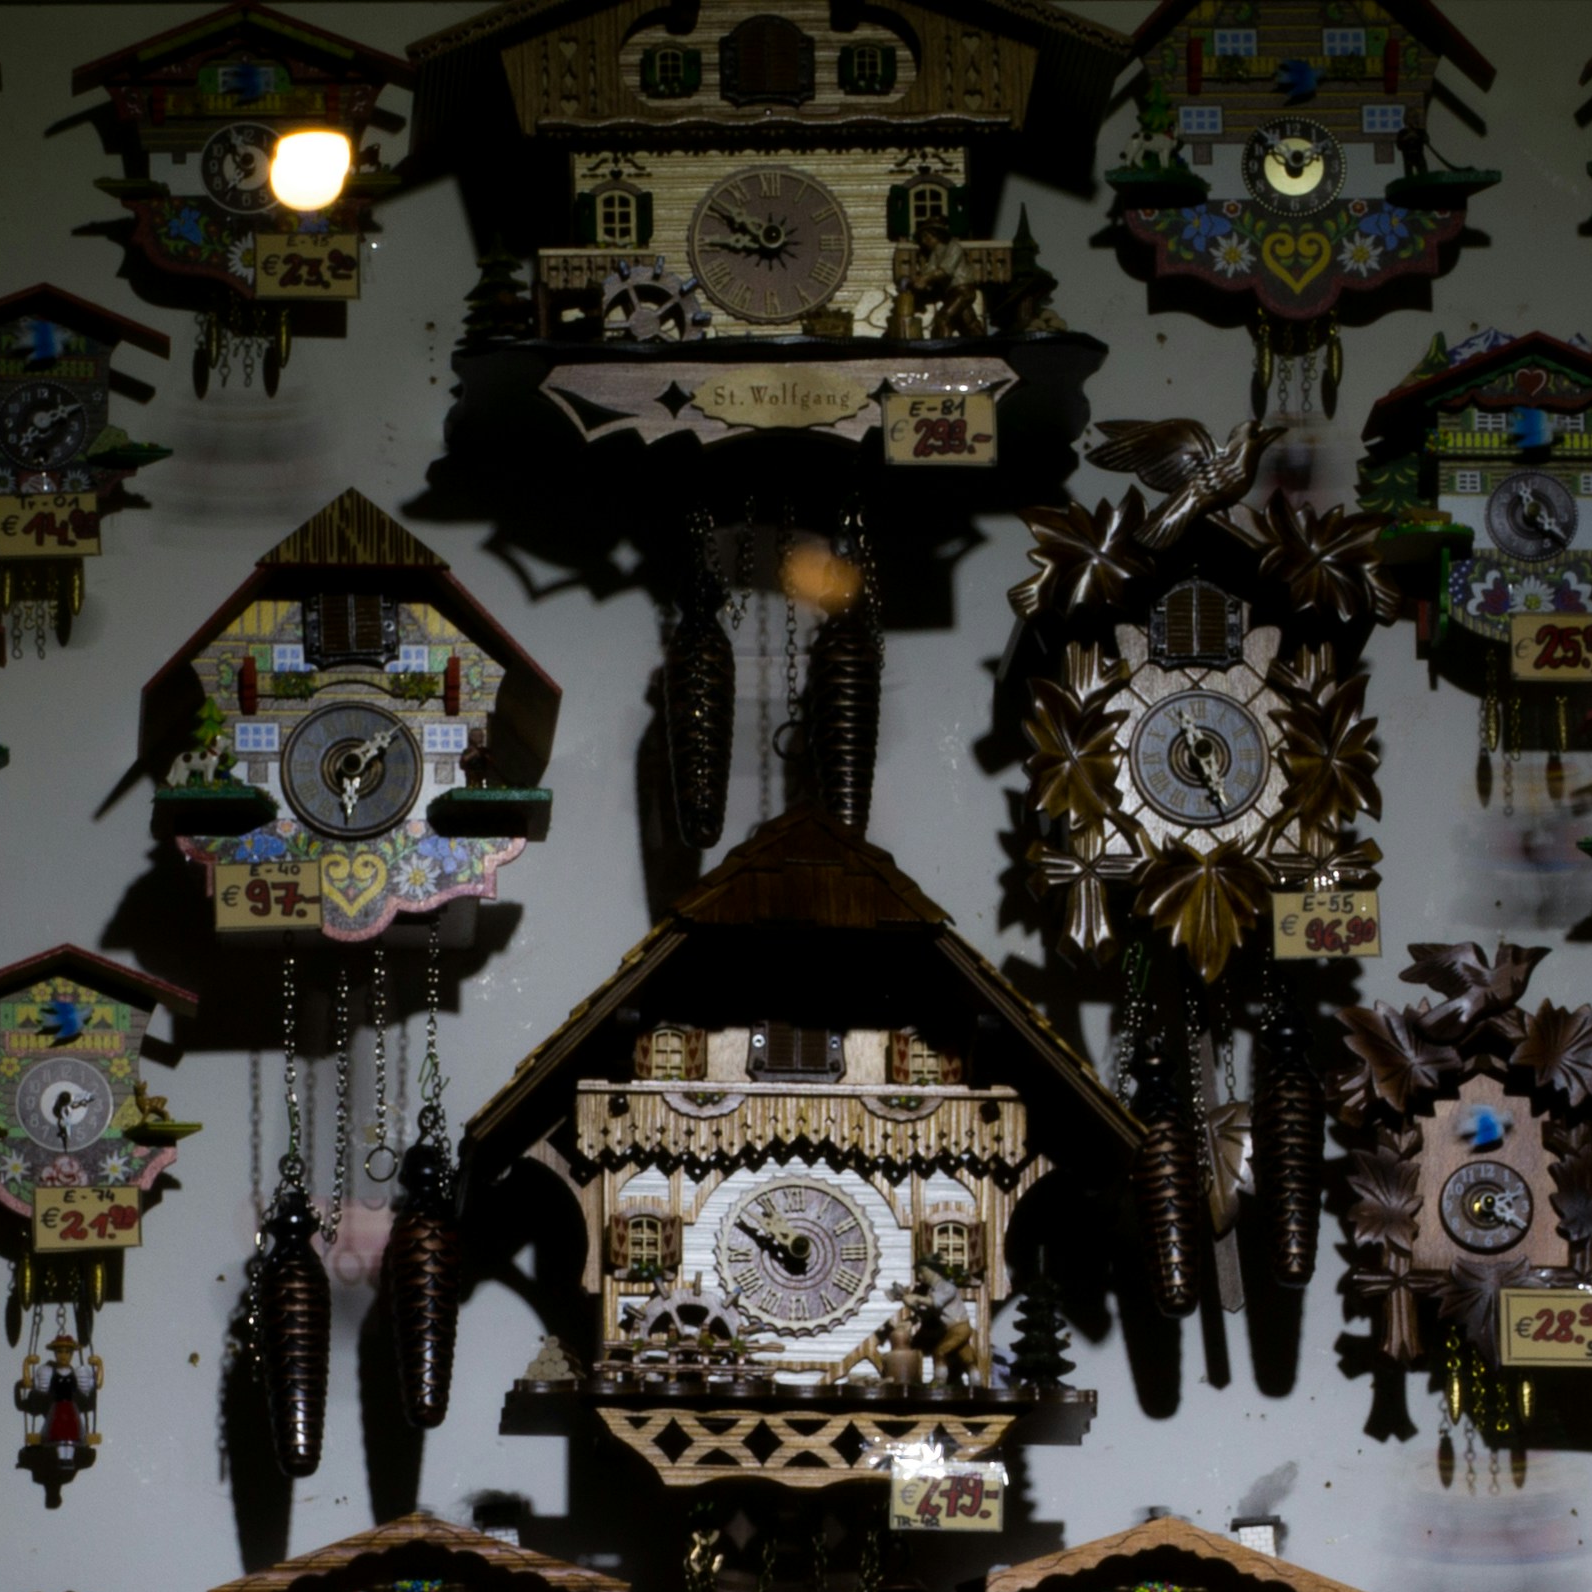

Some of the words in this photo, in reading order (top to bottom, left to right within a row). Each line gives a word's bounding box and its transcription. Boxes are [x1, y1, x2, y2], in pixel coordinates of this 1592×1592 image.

[262, 255, 279, 276] €
[714, 388, 744, 406] St.
[750, 383, 850, 409] Wolfgang
[891, 420, 911, 442] €
[1, 516, 18, 536] €
[1516, 639, 1533, 659] €
[222, 885, 241, 907] €
[1280, 915, 1298, 937] €
[41, 1207, 60, 1228] €
[1515, 1317, 1534, 1338] €
